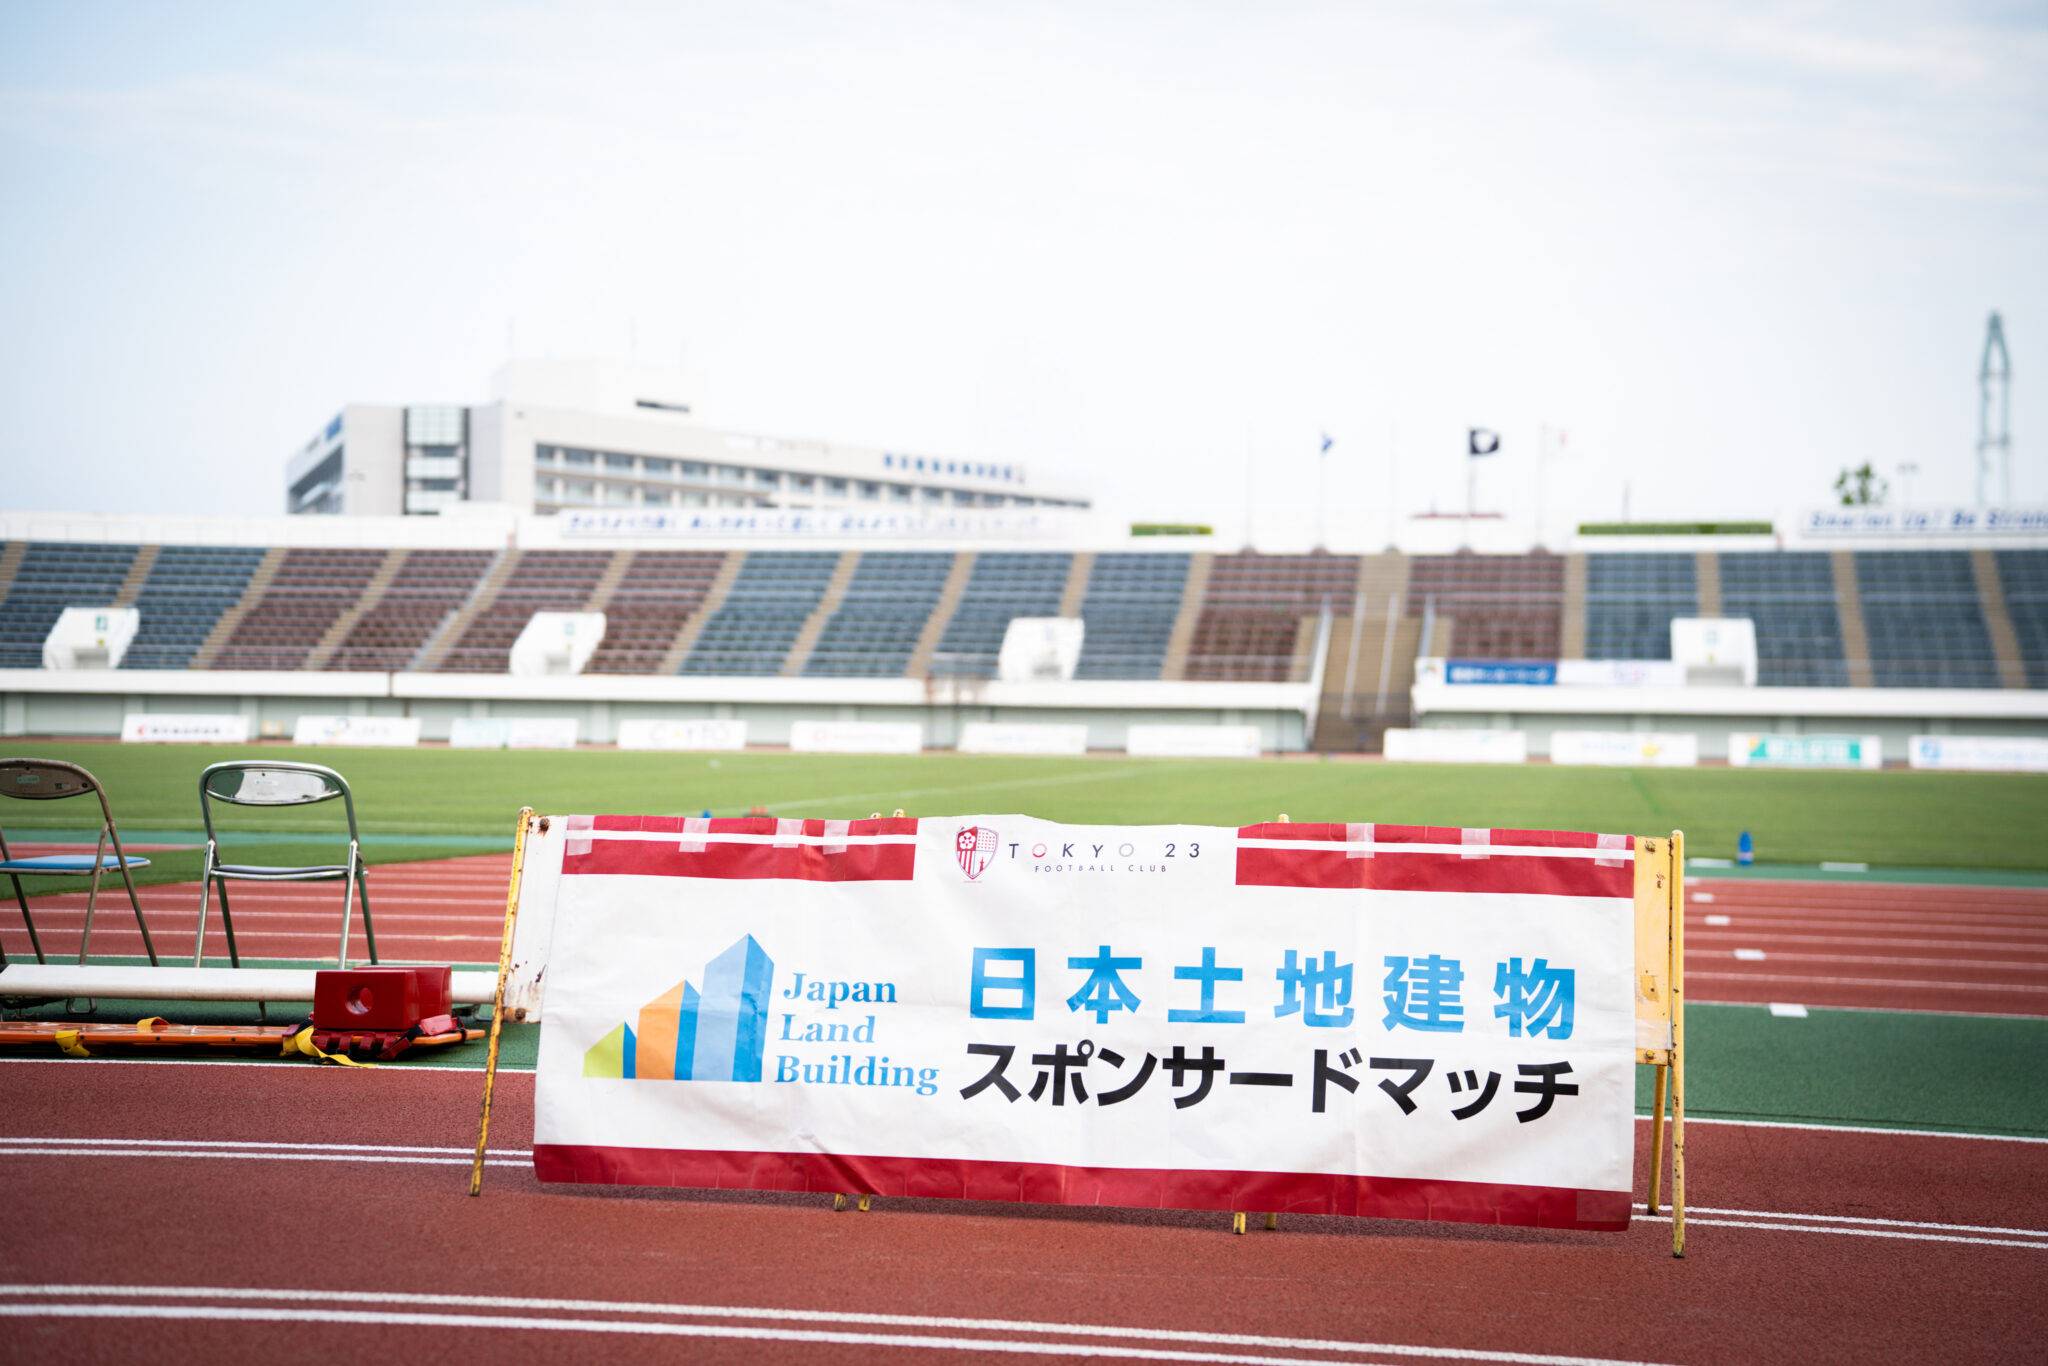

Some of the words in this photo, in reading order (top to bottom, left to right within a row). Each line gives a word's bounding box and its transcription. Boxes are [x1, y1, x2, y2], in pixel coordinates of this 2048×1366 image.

[1008, 842, 1135, 859] TOKYO
[1163, 842, 1200, 859] 23
[1034, 864, 1115, 873] FOOTBALL
[1127, 864, 1167, 873] CLUB
[783, 972, 898, 1009] Japan
[969, 944, 1576, 1040] 日本土地建物
[779, 1013, 876, 1044] Land
[774, 1054, 940, 1097] Building
[959, 1039, 1579, 1124] スポンサードマッチ
